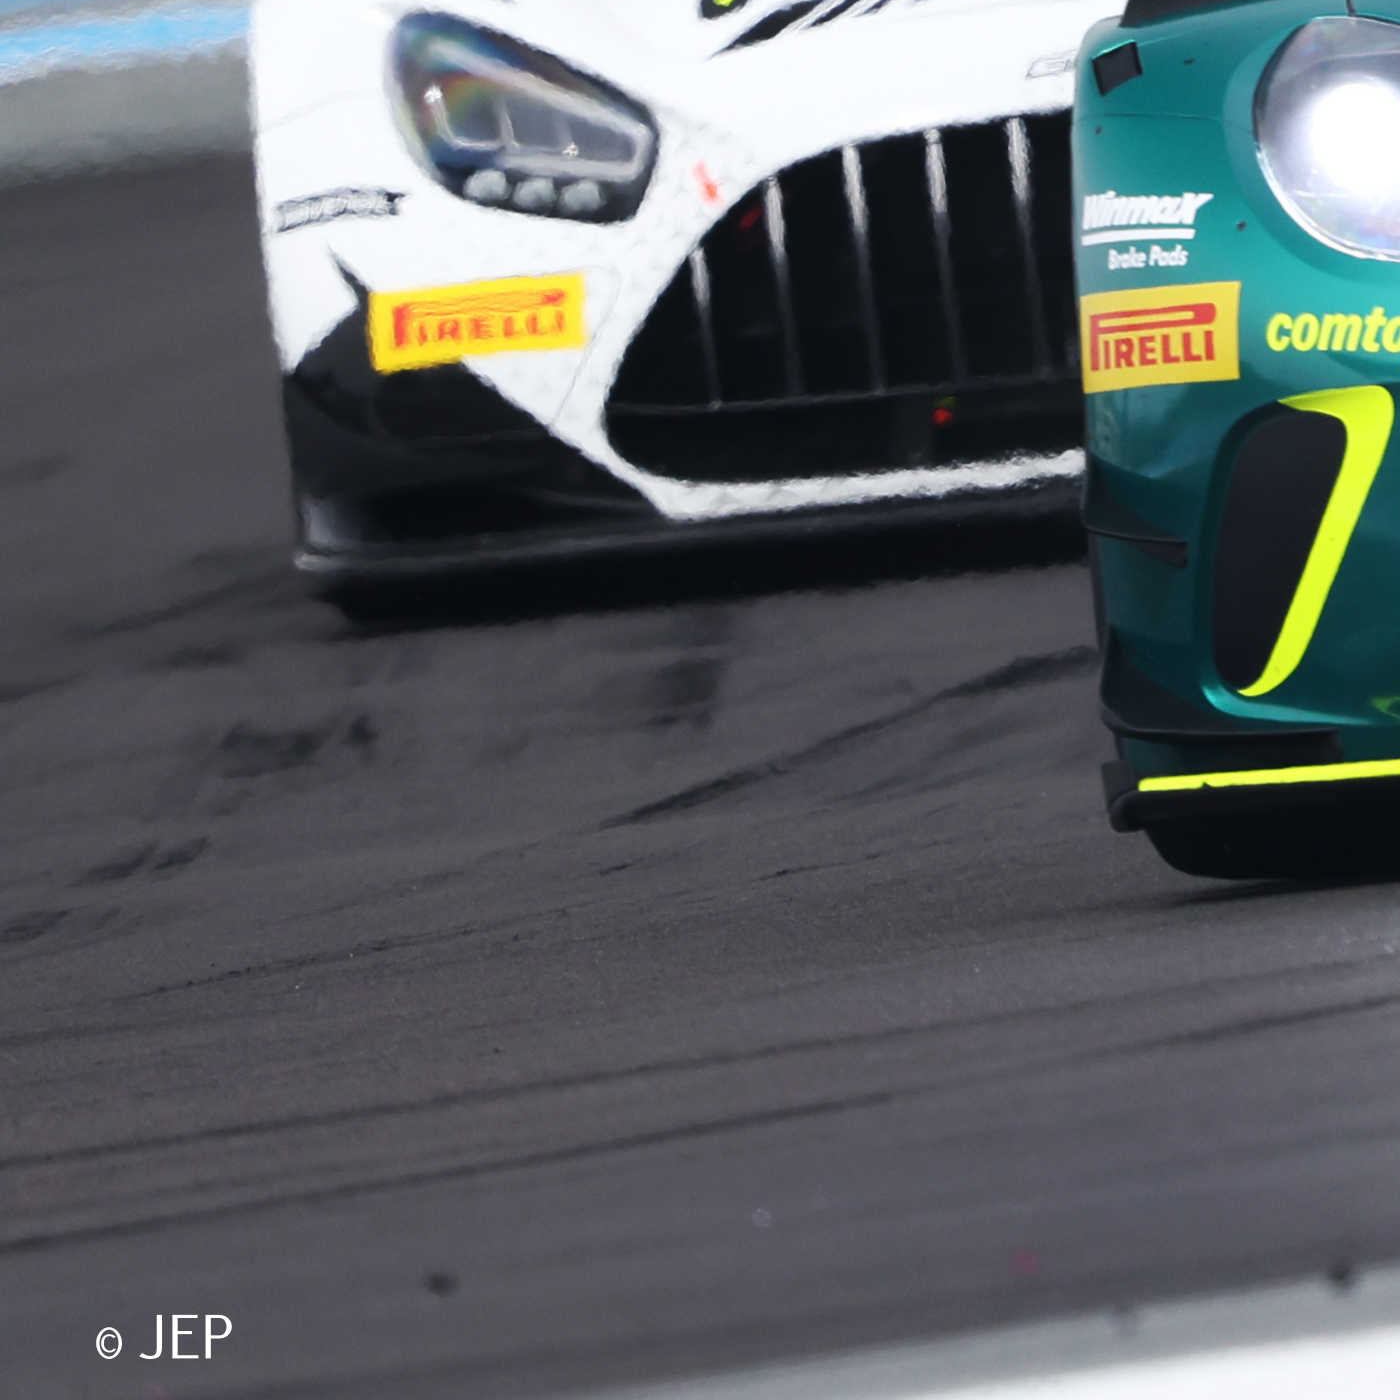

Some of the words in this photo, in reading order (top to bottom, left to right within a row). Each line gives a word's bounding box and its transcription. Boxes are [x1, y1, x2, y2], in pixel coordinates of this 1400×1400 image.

[1107, 246, 1147, 271] Brake
[1148, 243, 1189, 267] Pads
[392, 287, 565, 349] PIRELLI
[1089, 302, 1217, 372] PIRELLI
